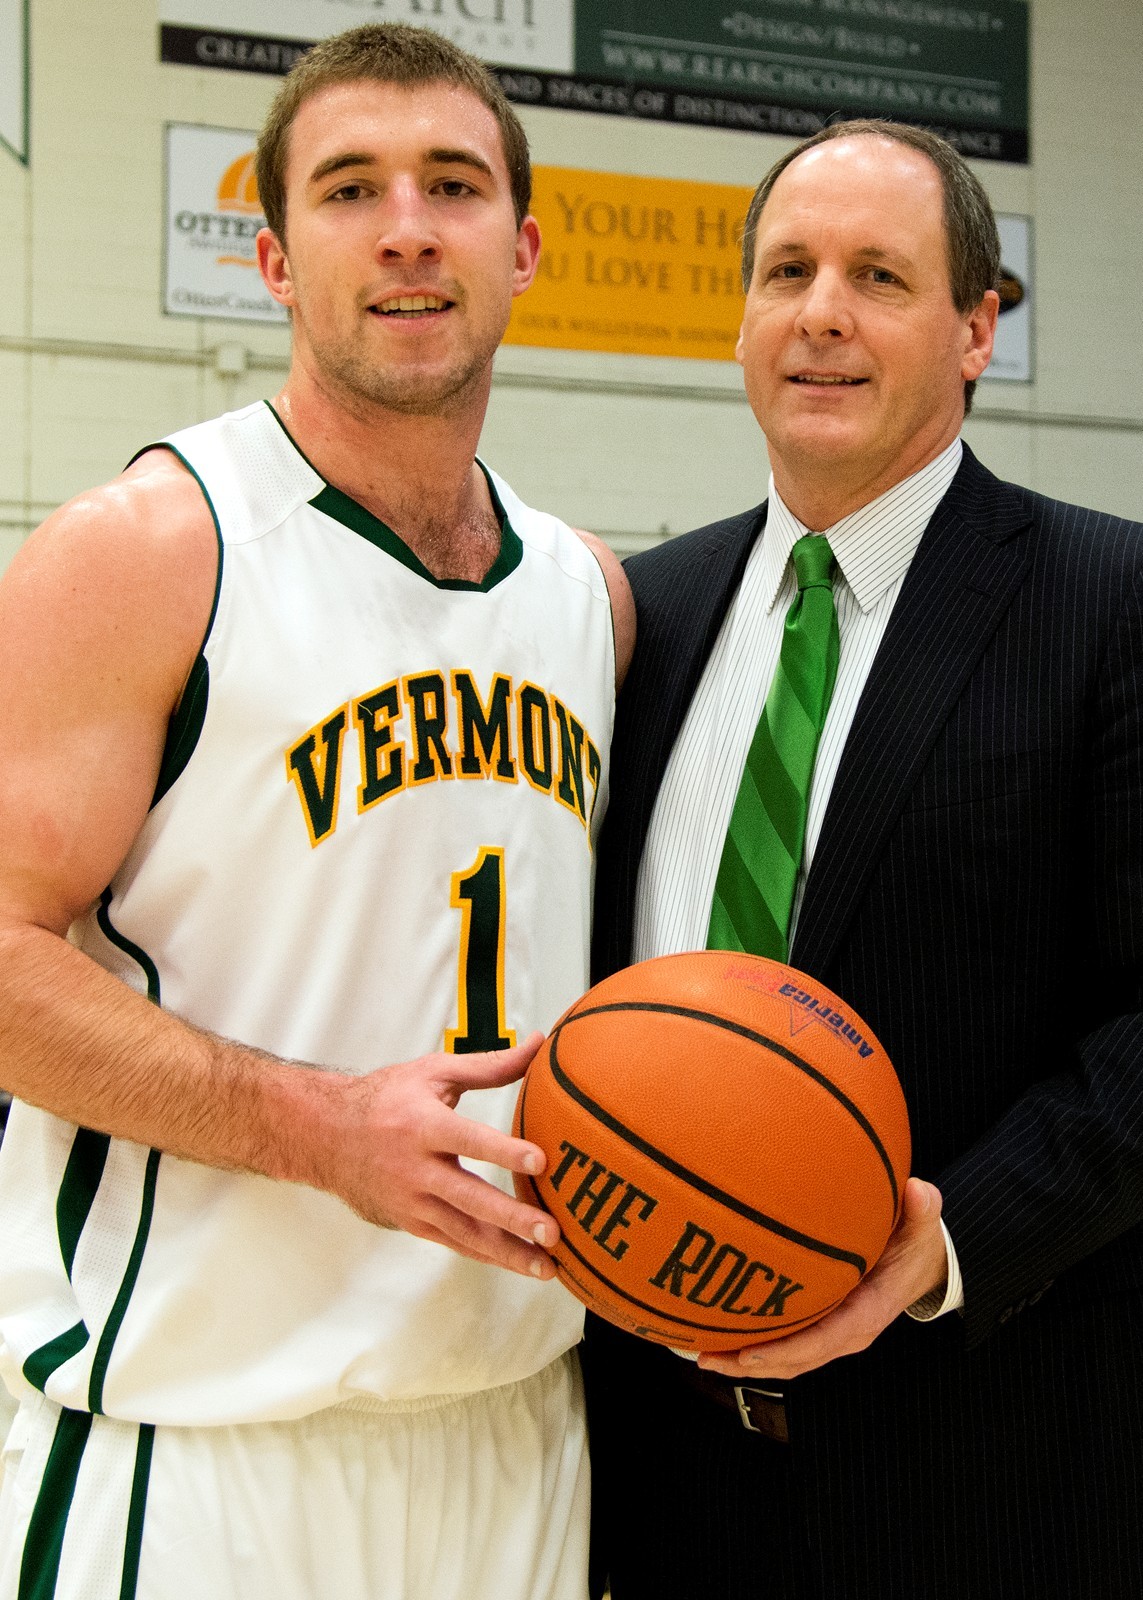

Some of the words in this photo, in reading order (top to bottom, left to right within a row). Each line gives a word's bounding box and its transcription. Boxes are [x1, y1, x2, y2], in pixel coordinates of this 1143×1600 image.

[195, 35, 299, 70] CREATI
[499, 72, 543, 99] ND
[633, 88, 667, 113] OF
[556, 191, 679, 244] YOUR
[585, 251, 672, 292] LOVE
[444, 846, 516, 1054] 1
[778, 983, 874, 1058] America
[549, 1140, 659, 1262] THE
[648, 1221, 803, 1317] ROCK
